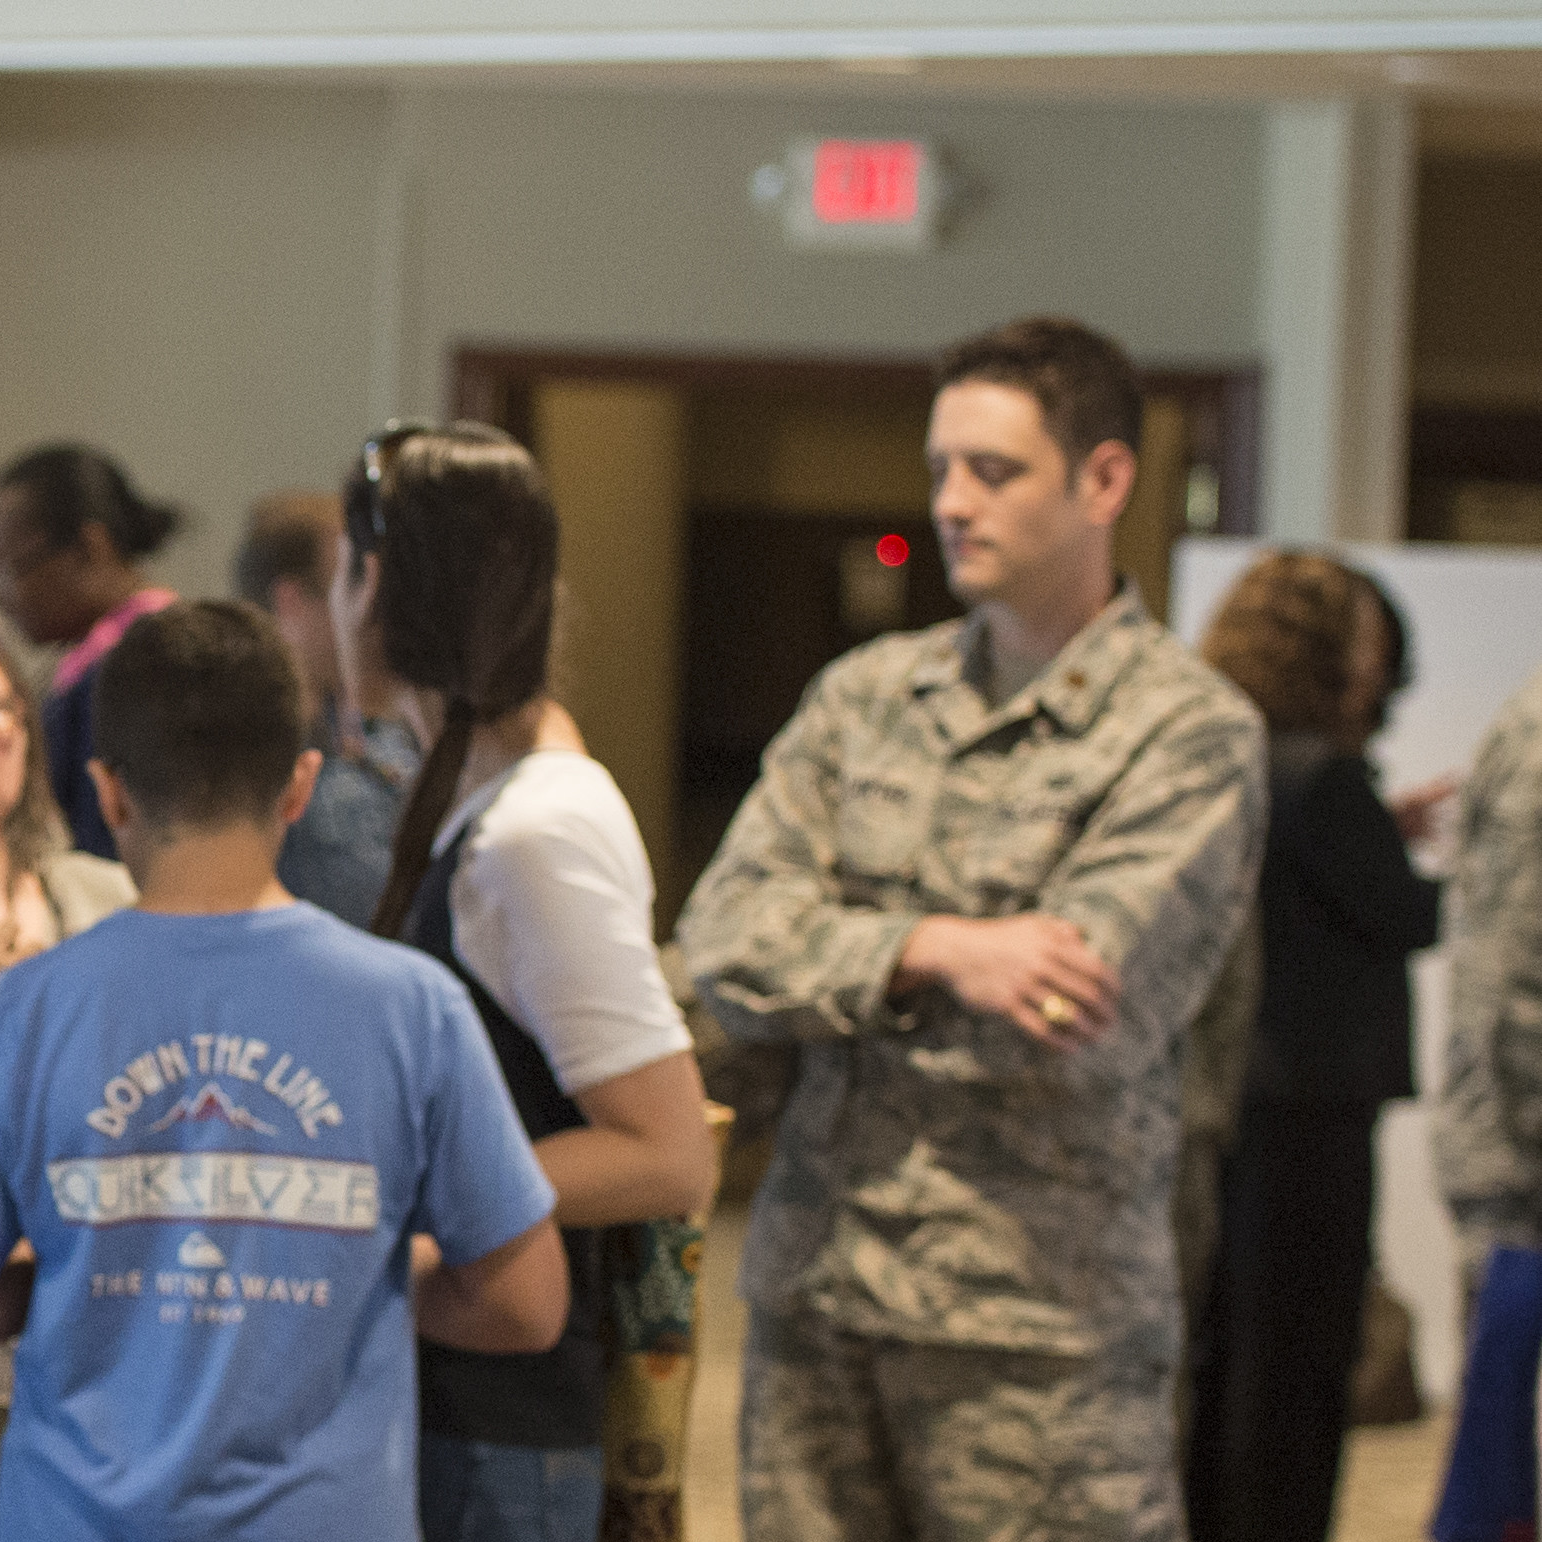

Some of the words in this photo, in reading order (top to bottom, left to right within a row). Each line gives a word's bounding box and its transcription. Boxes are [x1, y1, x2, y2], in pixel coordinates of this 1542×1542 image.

[86, 1039, 191, 1139] DOWN
[190, 1033, 268, 1082] THE
[263, 1053, 344, 1139] LINE
[239, 1272, 331, 1307] WAVE
